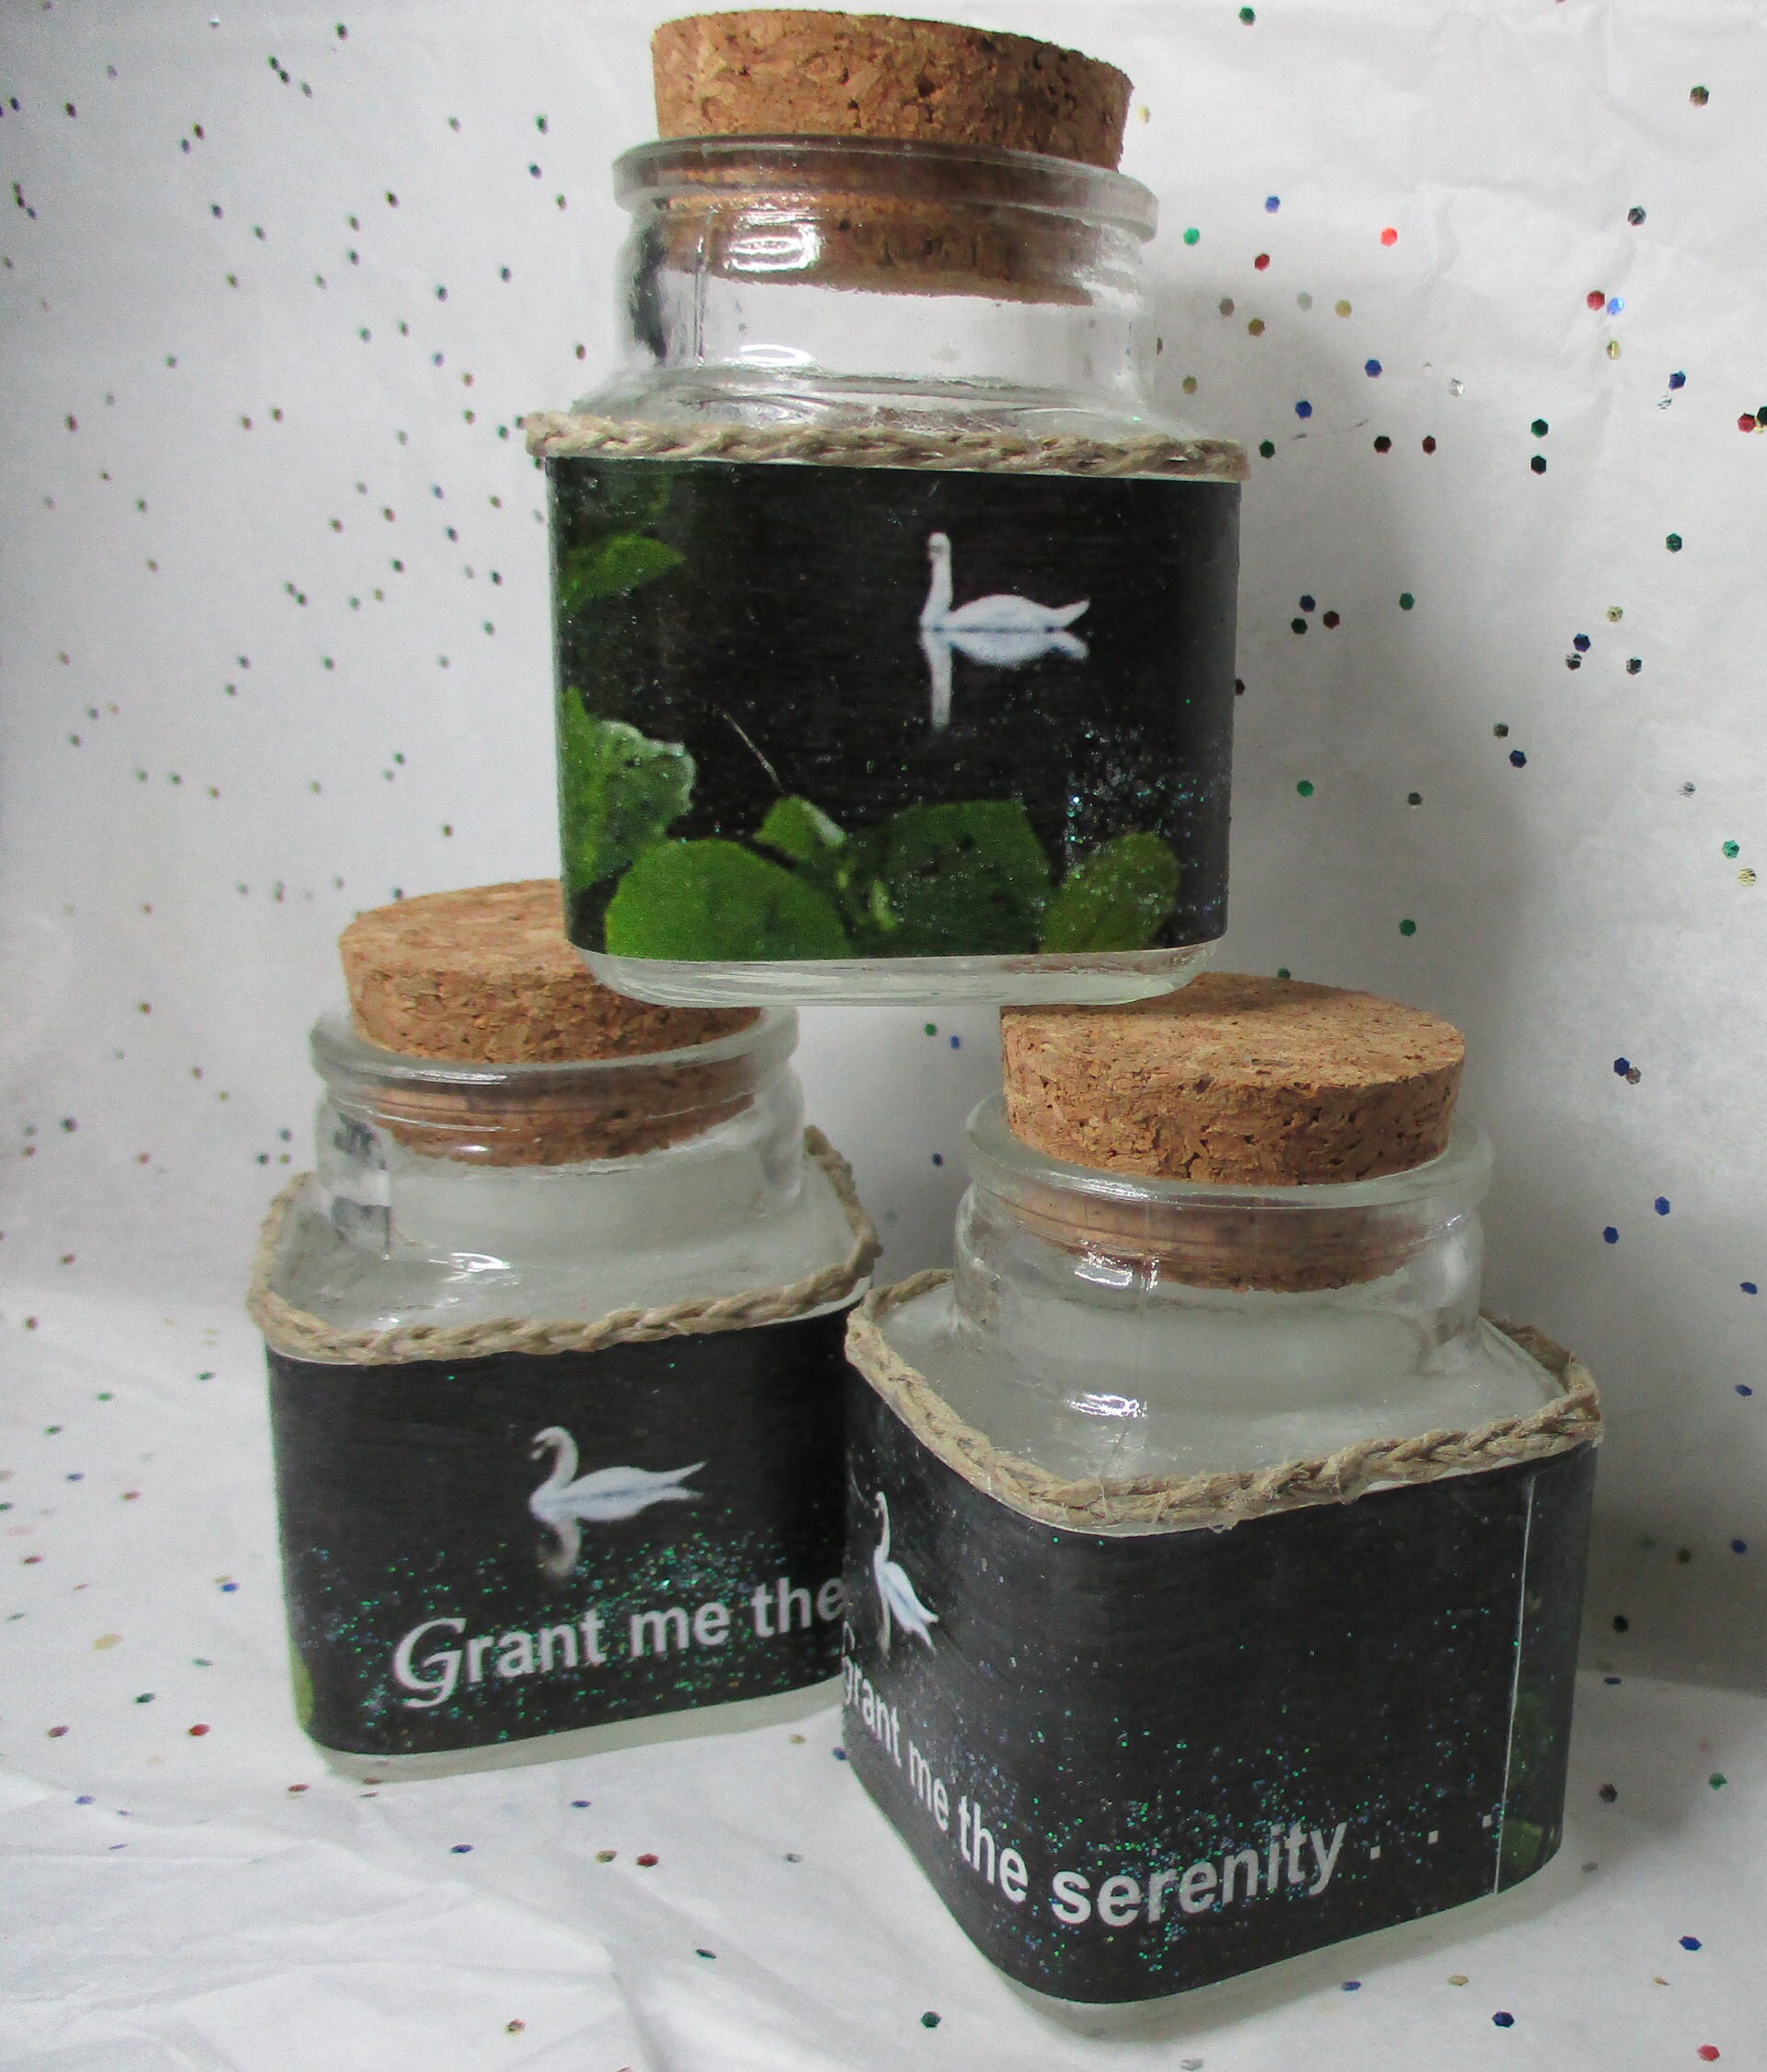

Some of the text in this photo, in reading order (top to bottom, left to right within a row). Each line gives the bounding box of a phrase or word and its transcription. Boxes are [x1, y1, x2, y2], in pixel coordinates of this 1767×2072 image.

[392, 1577, 844, 1710] Grant me the
[908, 1739, 949, 1831] me
[958, 1795, 1029, 1904] the
[1051, 1821, 1348, 1926] serenity
